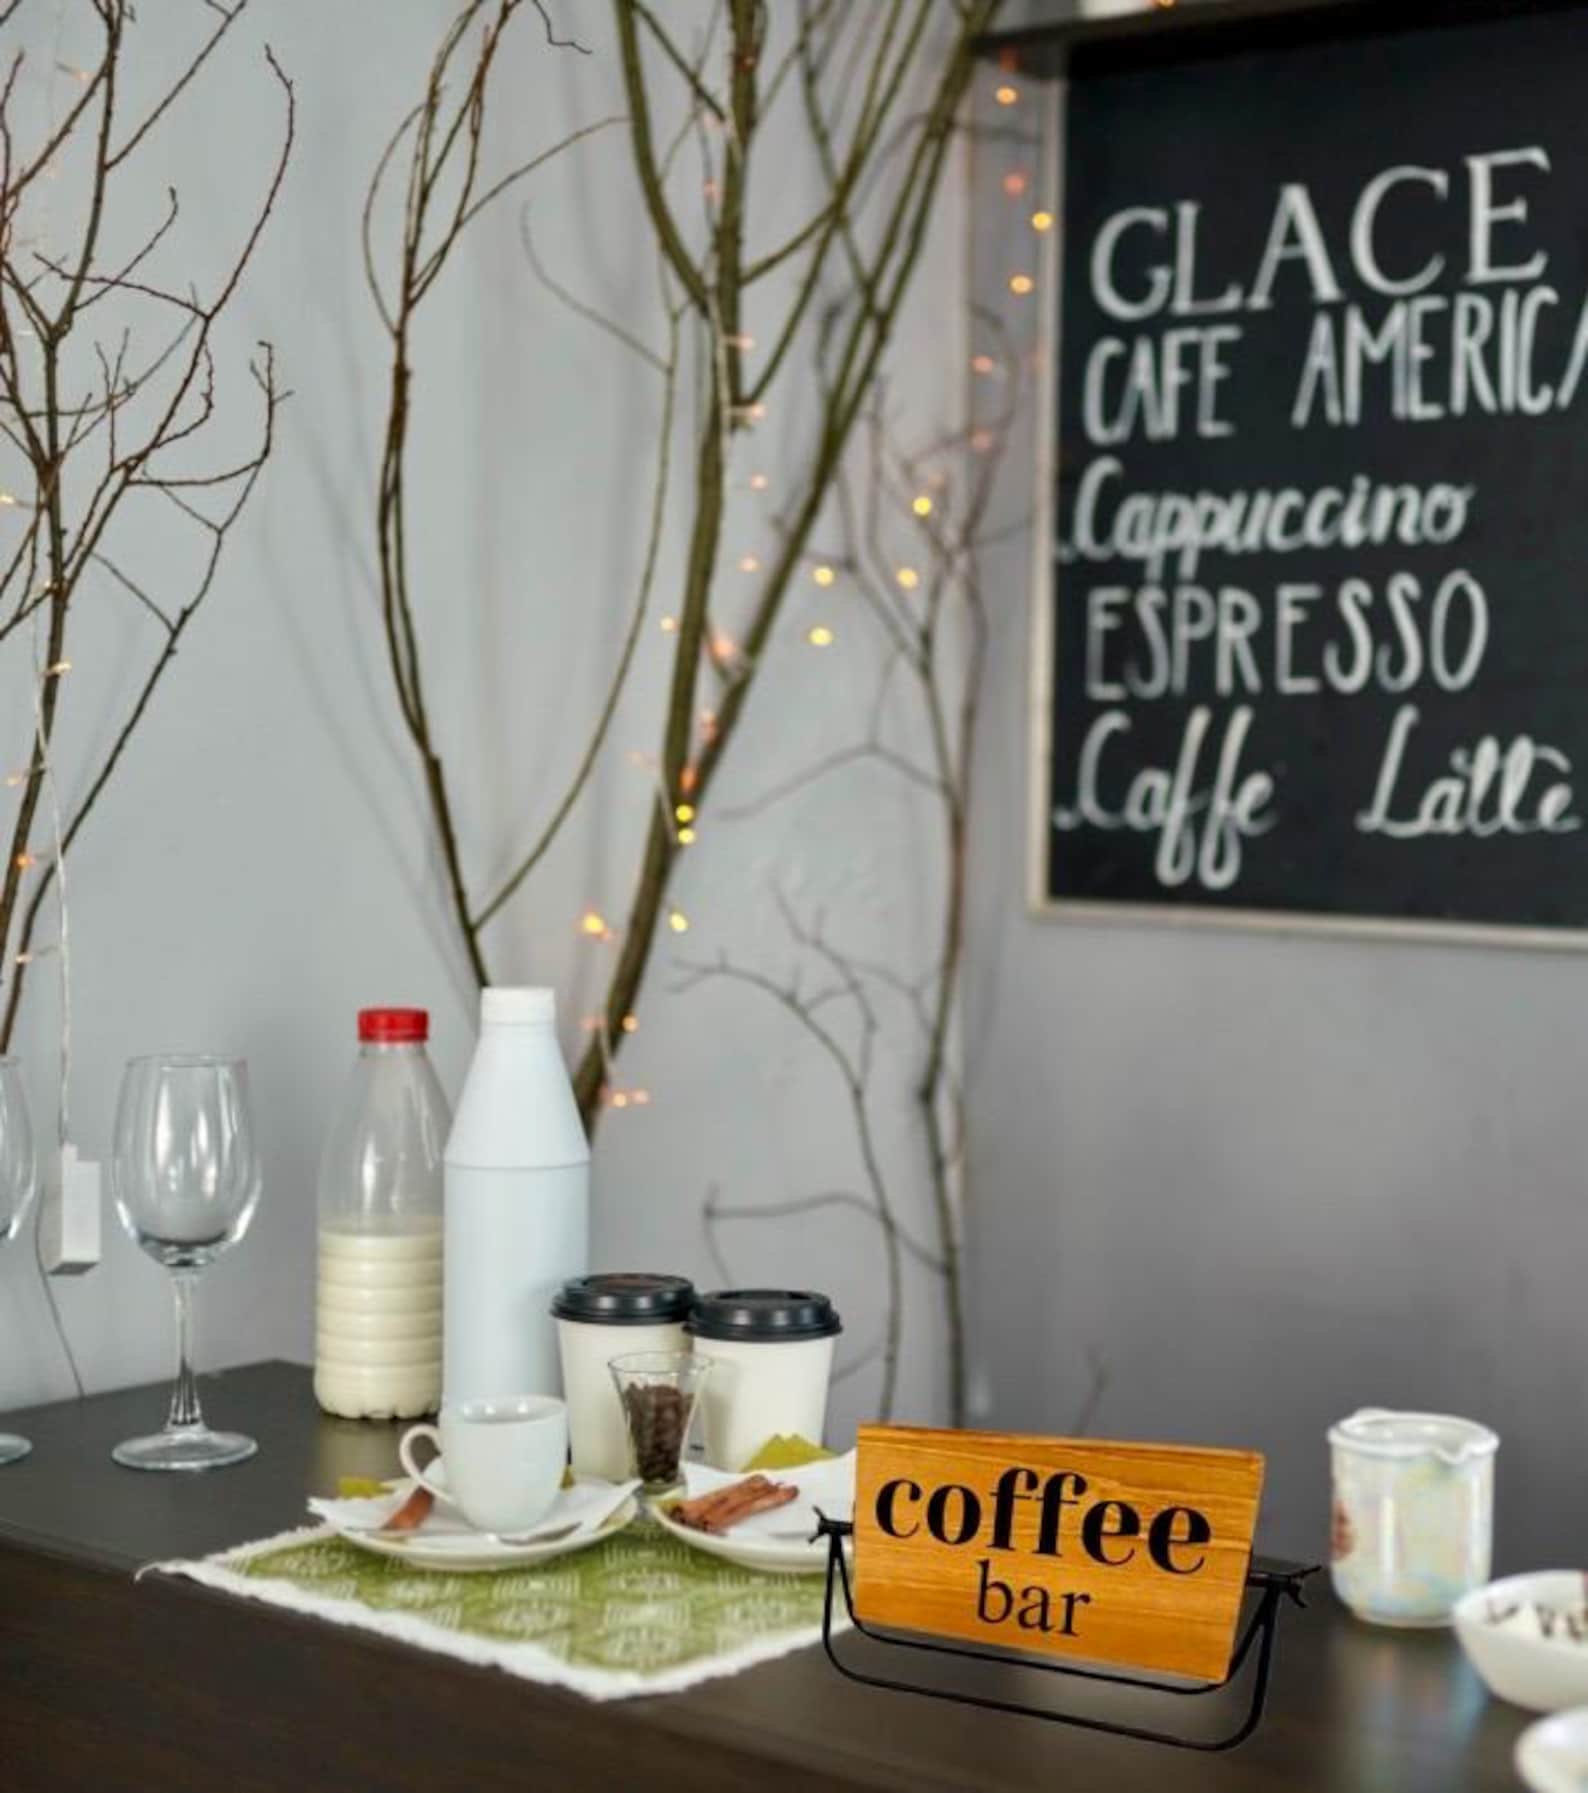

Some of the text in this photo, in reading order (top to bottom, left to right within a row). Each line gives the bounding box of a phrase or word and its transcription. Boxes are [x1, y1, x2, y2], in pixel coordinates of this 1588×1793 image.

[1090, 146, 1551, 321] GLACE
[1083, 325, 1242, 445] CAFE
[1056, 456, 1476, 582] Cappuccino
[1086, 569, 1489, 700] ESPRESSO
[1053, 703, 1582, 889] Caffe Latte
[875, 1467, 1212, 1575] coffee
[976, 1559, 1092, 1636] bar
